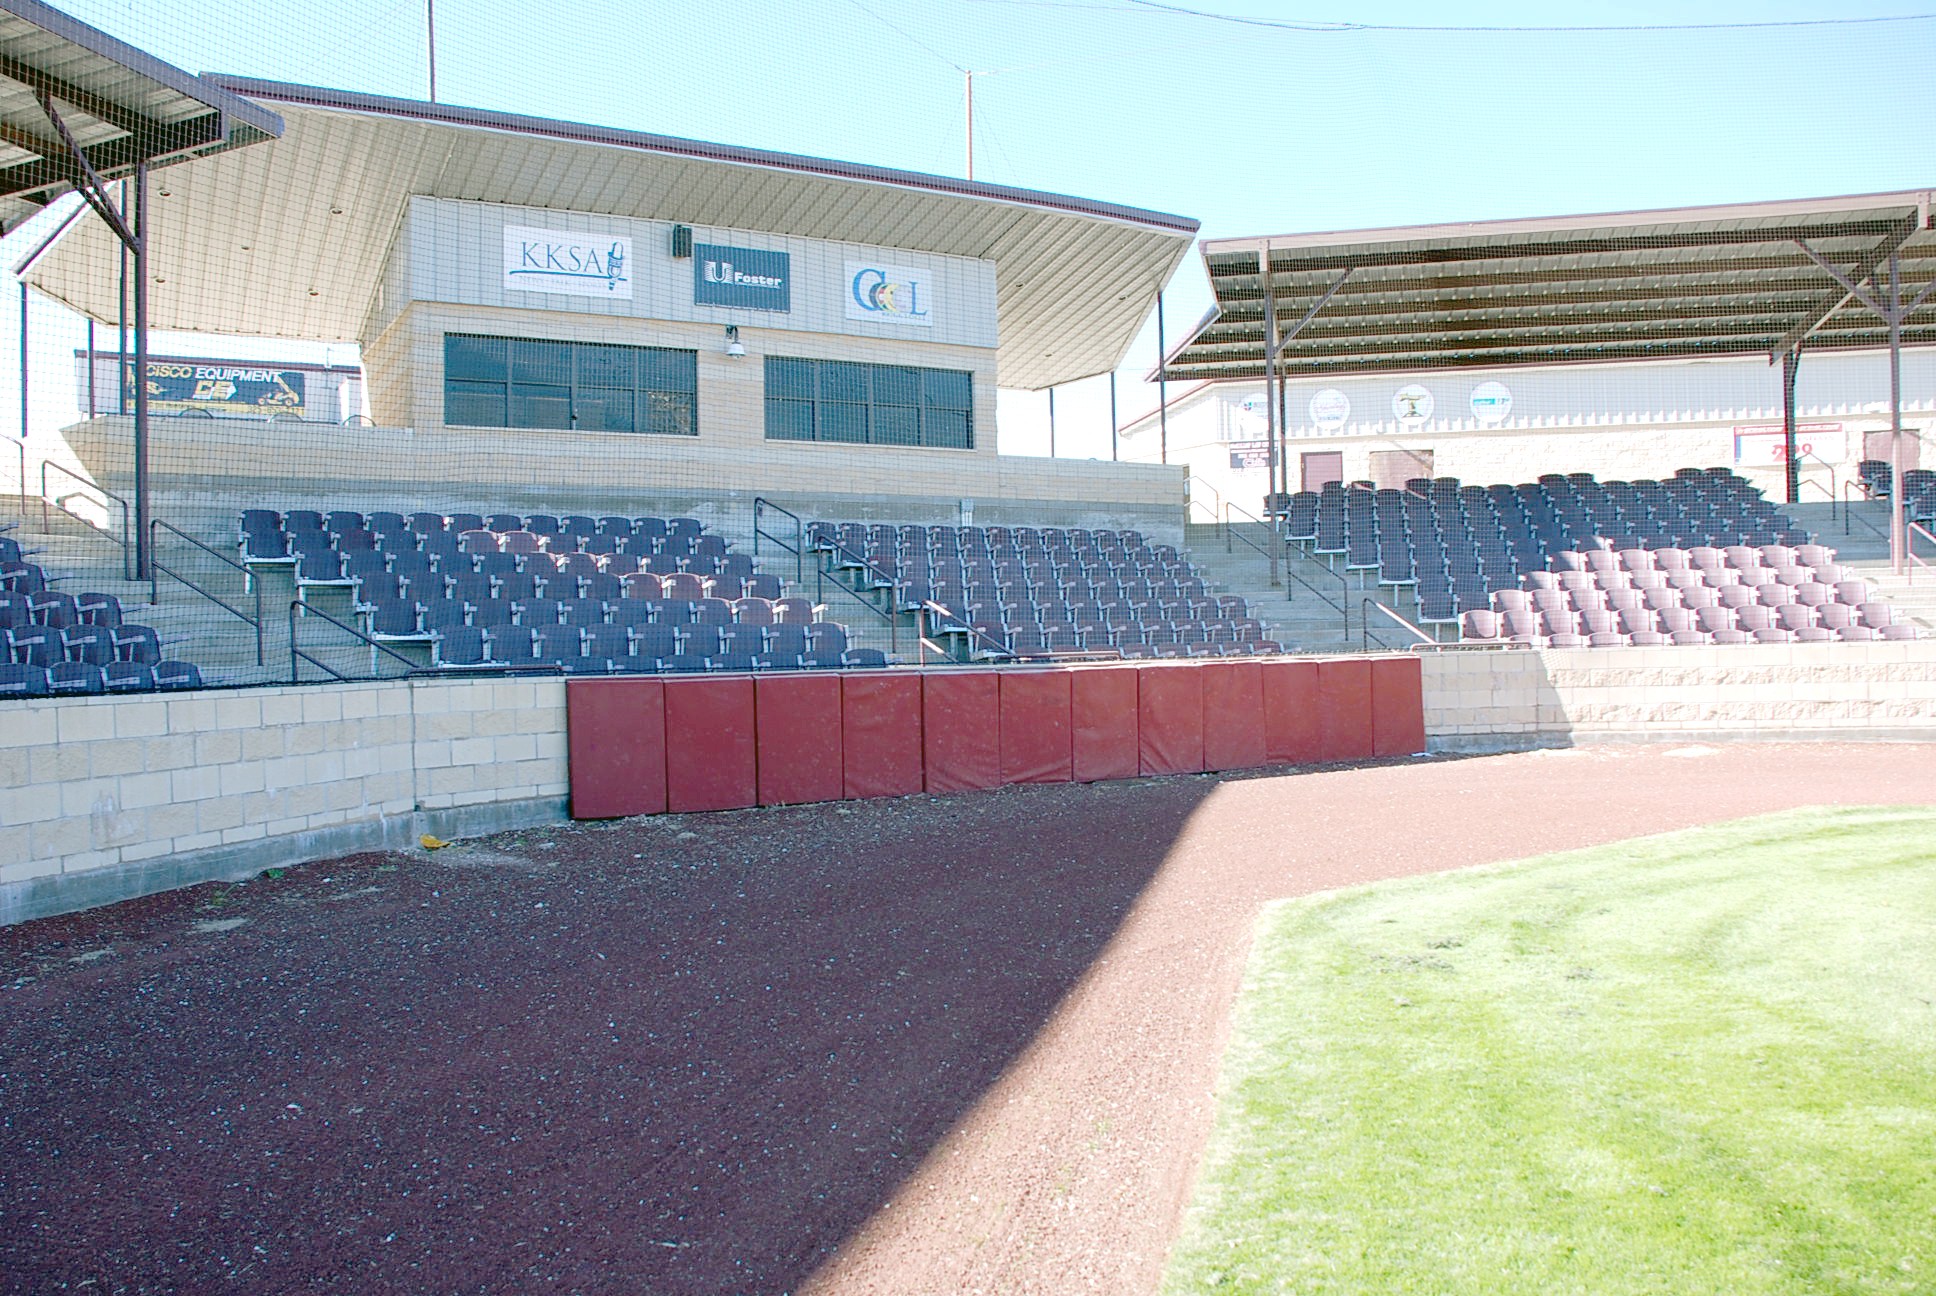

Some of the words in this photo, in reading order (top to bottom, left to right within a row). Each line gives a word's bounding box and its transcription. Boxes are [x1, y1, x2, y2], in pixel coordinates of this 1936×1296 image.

[522, 241, 603, 274] KKSA
[734, 271, 782, 286] Foster
[194, 366, 281, 384] EQUIPMENT
